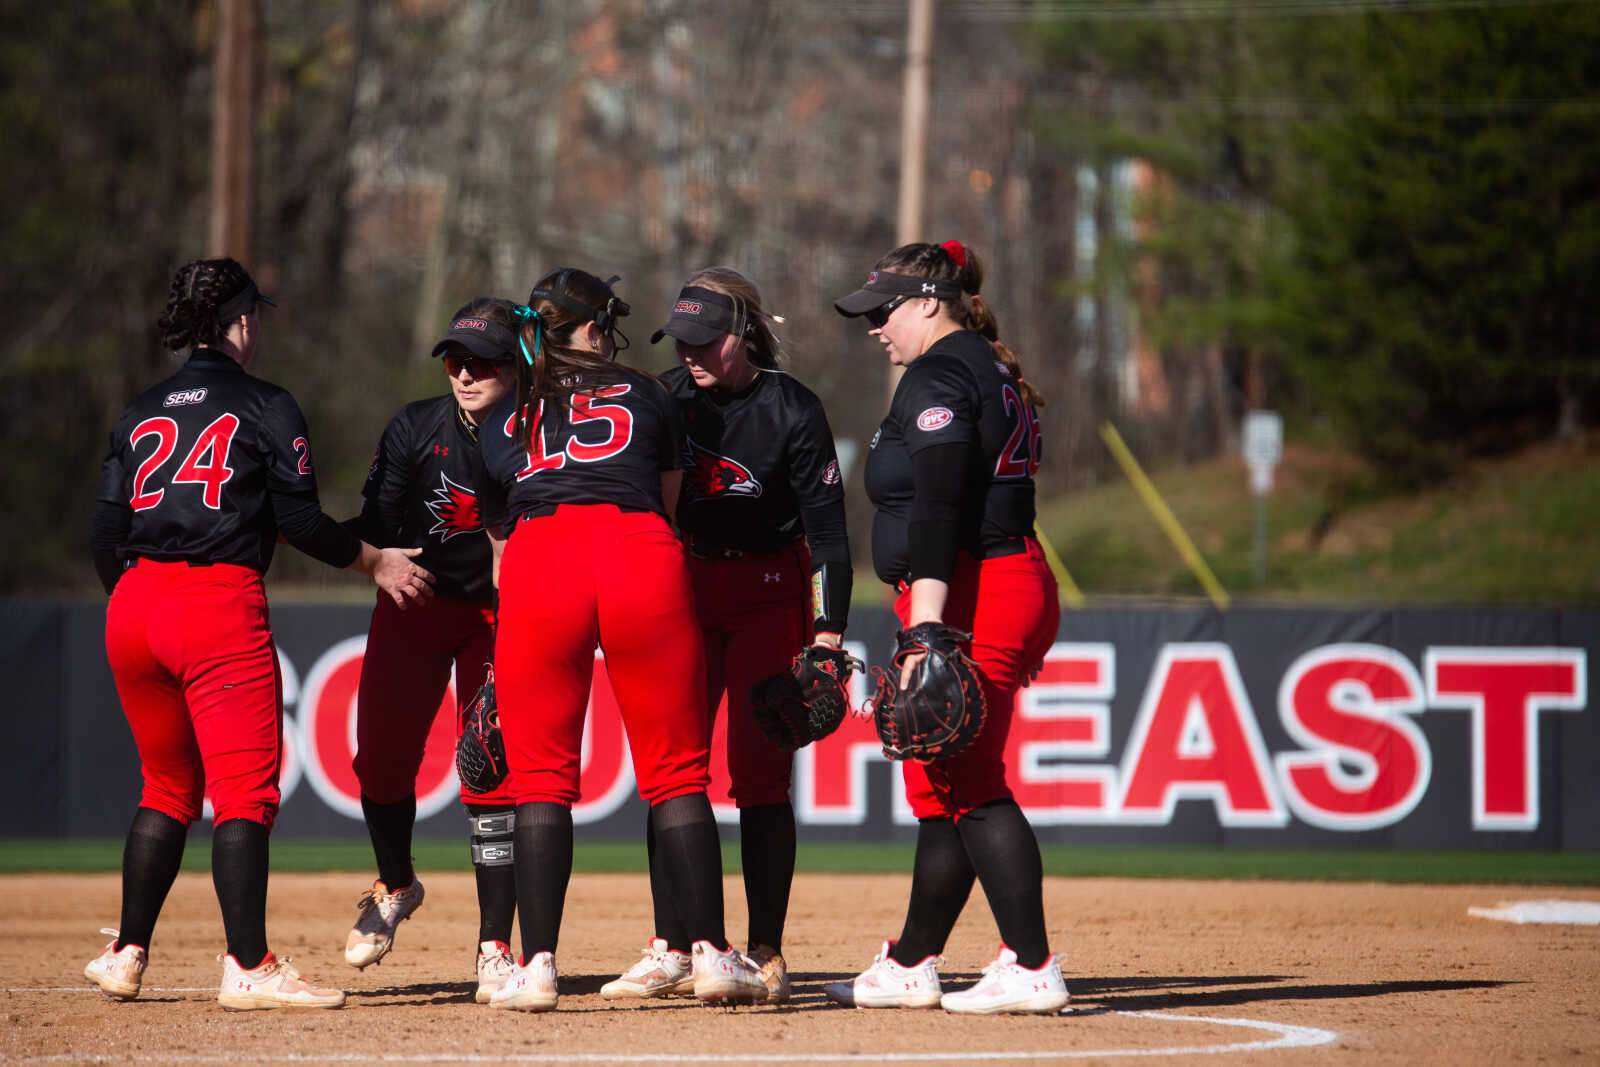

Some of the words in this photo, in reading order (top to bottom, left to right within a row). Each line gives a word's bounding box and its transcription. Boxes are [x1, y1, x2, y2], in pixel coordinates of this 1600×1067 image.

[455, 319, 488, 331] SEMO
[164, 388, 207, 407] SEMO
[504, 384, 633, 482] 15
[130, 413, 240, 512] 24
[203, 636, 1587, 830] OEAST
